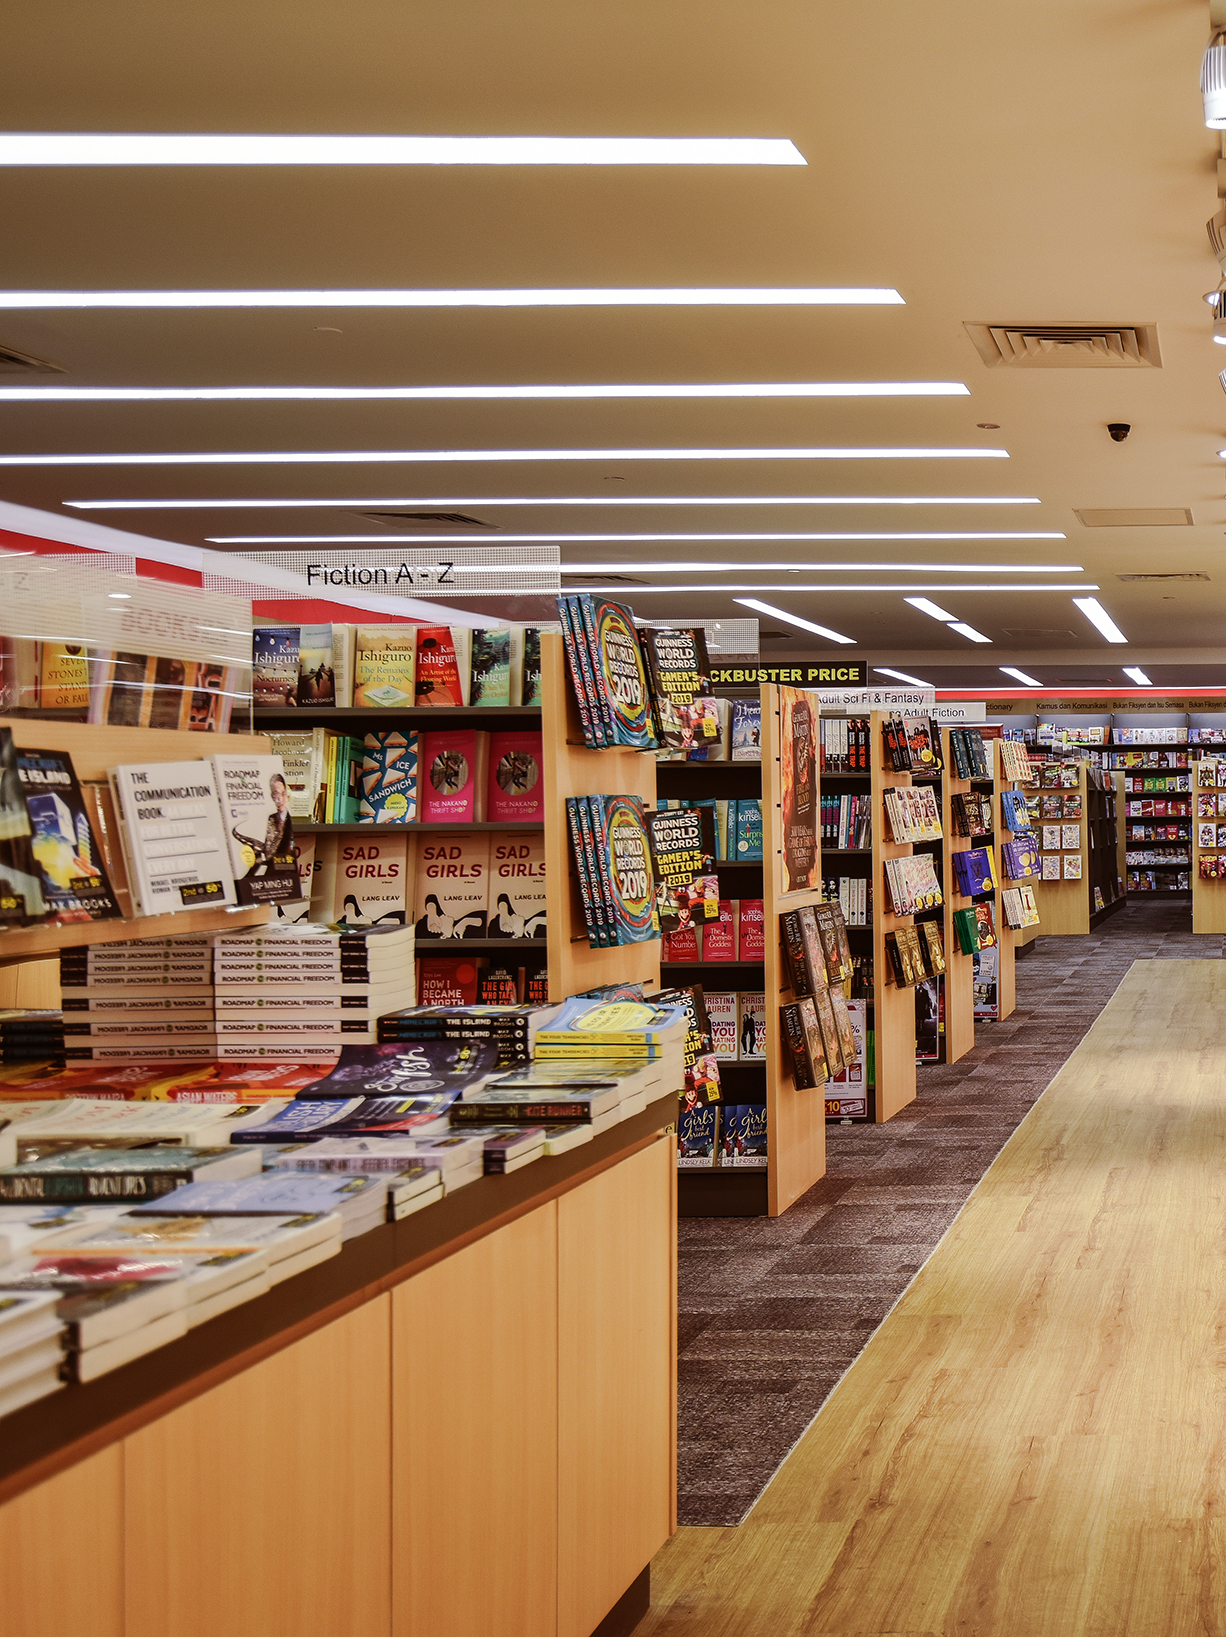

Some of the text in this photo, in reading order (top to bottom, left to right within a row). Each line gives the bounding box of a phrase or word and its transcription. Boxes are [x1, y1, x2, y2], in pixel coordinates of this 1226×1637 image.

[307, 564, 387, 585] Fiction
[395, 562, 414, 584] A
[438, 562, 454, 583] Z
[604, 630, 633, 648] GUINNESS
[655, 638, 693, 648] GUINNESS
[385, 642, 412, 652] Kazuo
[358, 650, 412, 665] Ishiguro
[559, 607, 572, 646] GUINNESS
[566, 645, 577, 673] WORLD
[572, 673, 587, 710] RECORDS
[606, 643, 636, 664] WORLD
[658, 648, 694, 659] WORLD
[60, 656, 86, 667] SEVEN
[659, 659, 697, 668] RECORDS
[48, 668, 82, 679] STONES
[359, 665, 410, 676] The Remains
[609, 660, 639, 678] RECORDS
[256, 674, 296, 684] Nocturnes
[659, 671, 699, 681] GAMER'S
[710, 667, 860, 683] CKBUSTER PRICE
[612, 676, 641, 706] 2019
[662, 680, 700, 692] EDITION
[55, 695, 68, 705] OR
[672, 694, 691, 703] 2019
[842, 693, 859, 704] Sci
[861, 693, 871, 703] Fi
[873, 693, 882, 703] &
[884, 692, 925, 706] Fantasy
[1036, 701, 1108, 710] Kamus dan Komunikasi
[1112, 701, 1127, 709] Bukan
[1129, 701, 1147, 710] Fiksyen
[1148, 701, 1158, 709] dan
[1165, 701, 1184, 709] Semasa
[1205, 701, 1223, 709] Fiksyen
[904, 706, 965, 718] Adult Fiction
[282, 759, 310, 768] Finkler
[395, 760, 411, 770] ICE
[131, 772, 150, 785] THE
[223, 770, 261, 779] ROADMAP
[226, 782, 262, 791] FINANCIAL
[368, 778, 413, 803] SANDWICH
[134, 785, 212, 803] COMMUNICATION
[228, 791, 265, 801] FREEDOM
[652, 817, 699, 831] GUINNESS
[612, 826, 642, 839] GUINNESS
[653, 827, 699, 841] WORLD
[614, 839, 644, 857] WORLD
[656, 838, 700, 851] RECORDS
[342, 846, 380, 861] SAD
[423, 846, 462, 861] SAD
[495, 845, 531, 860] SAD
[656, 850, 701, 865] GAMER'S
[615, 856, 646, 871] RECORDS
[658, 860, 703, 875] EDITION
[345, 863, 400, 878] GIRLS
[426, 863, 482, 878] GIRLS
[250, 881, 263, 891] YAP
[264, 880, 280, 890] MING
[619, 871, 648, 900] 2019
[669, 874, 691, 886] 2019
[671, 933, 684, 941] Got
[708, 940, 732, 948] Goddess
[422, 980, 444, 990] HOW
[482, 981, 496, 991] THE
[529, 981, 543, 991] THE
[422, 989, 462, 999] BECAME
[482, 990, 496, 1000] WHO
[712, 1027, 736, 1037] YOU
[713, 1043, 736, 1053] YOU
